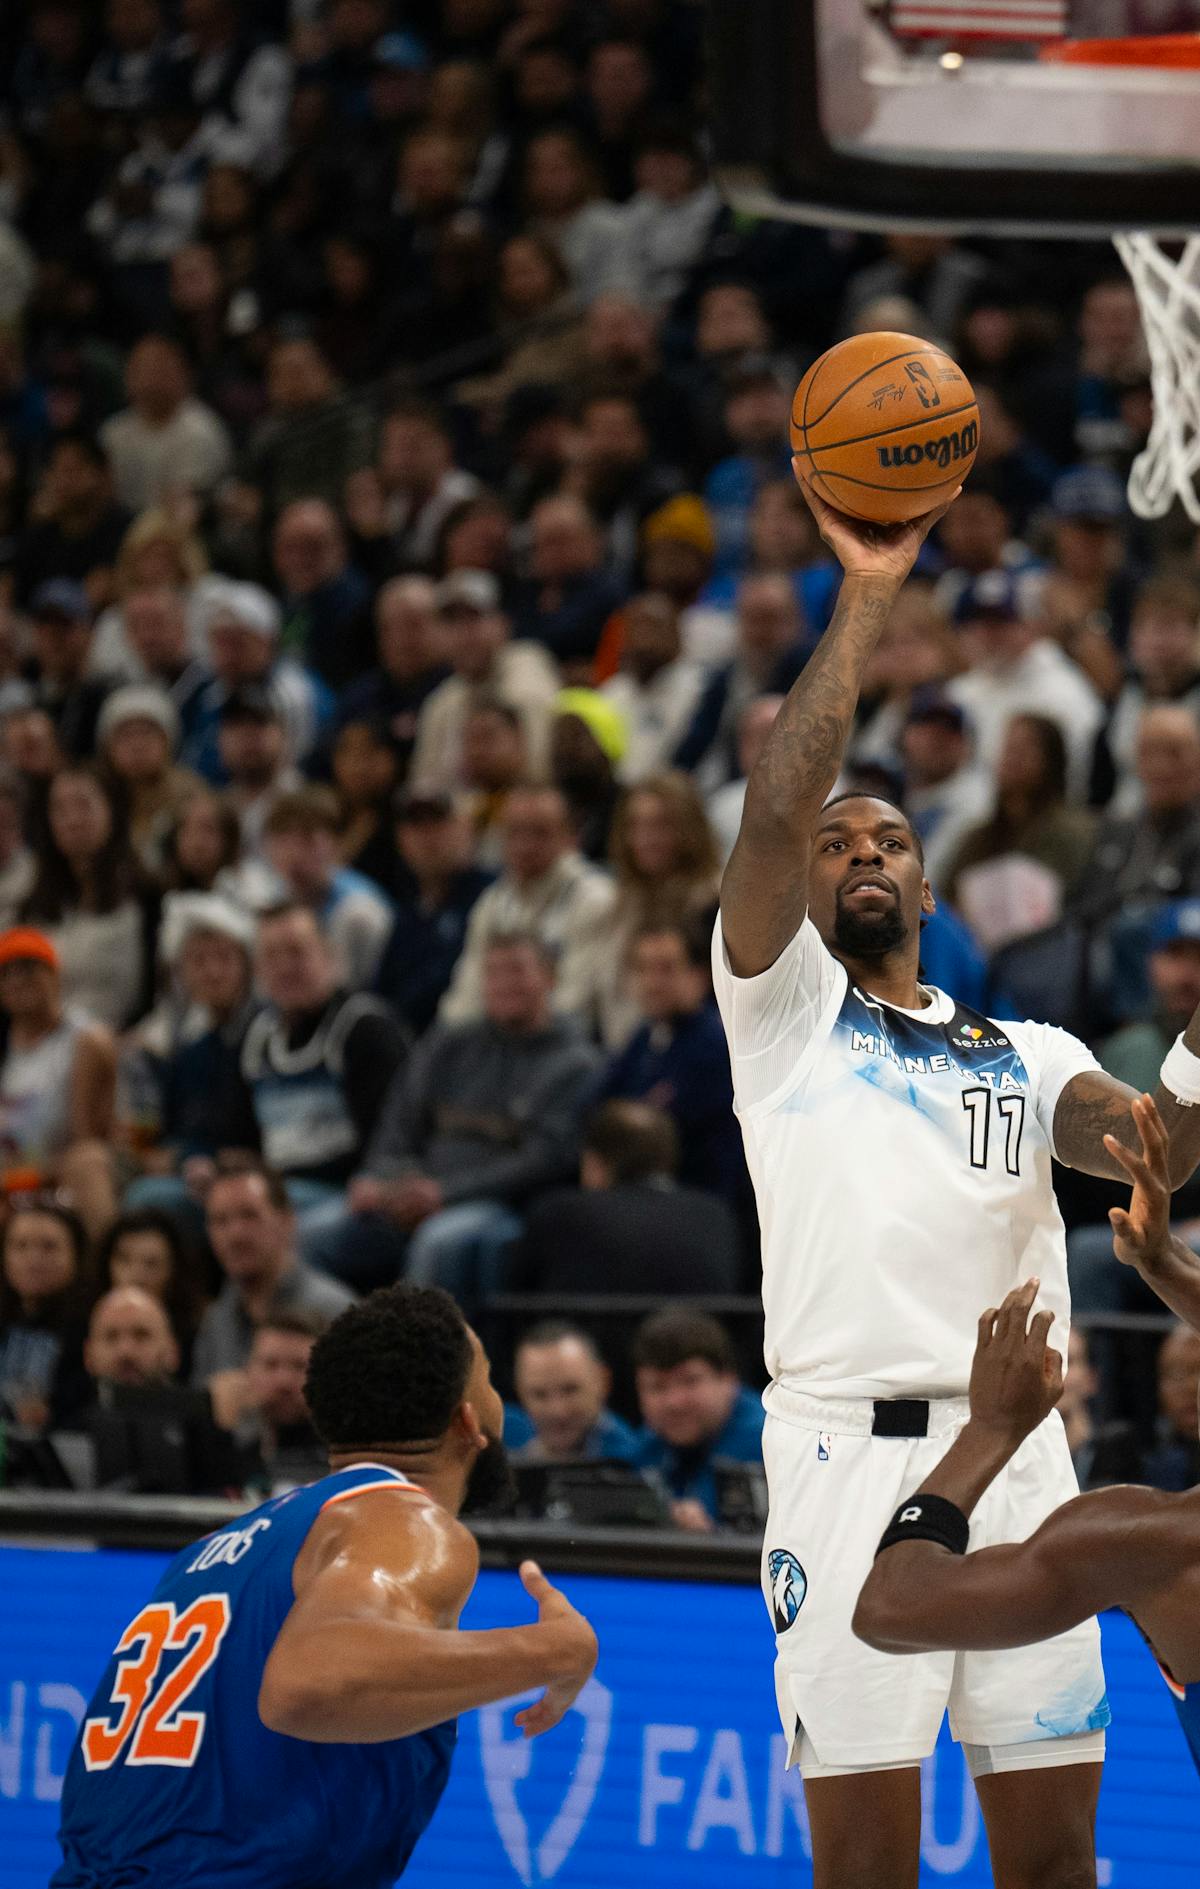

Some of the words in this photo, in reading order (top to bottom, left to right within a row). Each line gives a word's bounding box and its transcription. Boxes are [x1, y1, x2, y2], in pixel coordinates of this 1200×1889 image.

[877, 419, 978, 468] Wilson
[952, 1036, 1009, 1049] sezzle
[962, 1086, 1025, 1177] 11
[82, 1593, 230, 1772] 32
